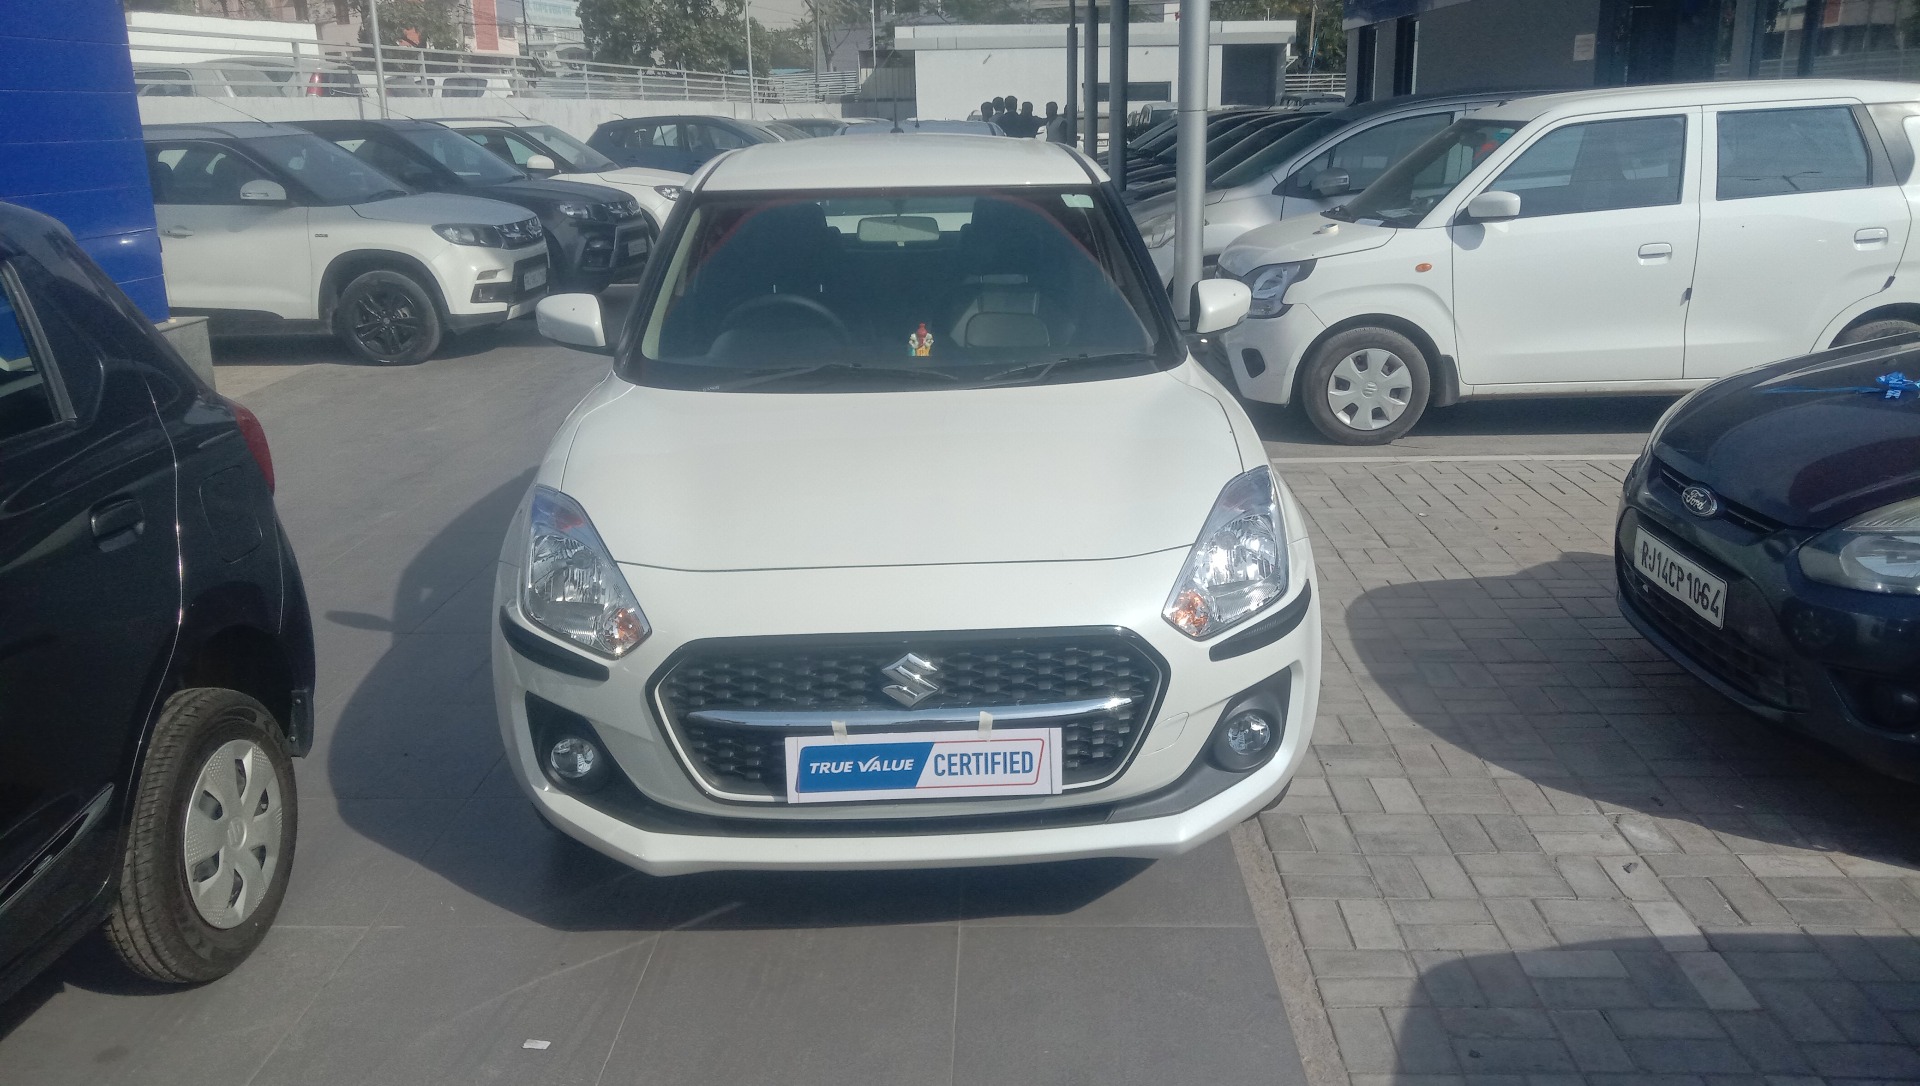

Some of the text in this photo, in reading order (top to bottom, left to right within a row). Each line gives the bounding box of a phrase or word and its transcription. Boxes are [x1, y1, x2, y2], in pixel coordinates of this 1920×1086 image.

[1685, 489, 1708, 511] Ford
[809, 751, 1034, 777] TRUE VALUE CERTIFIED
